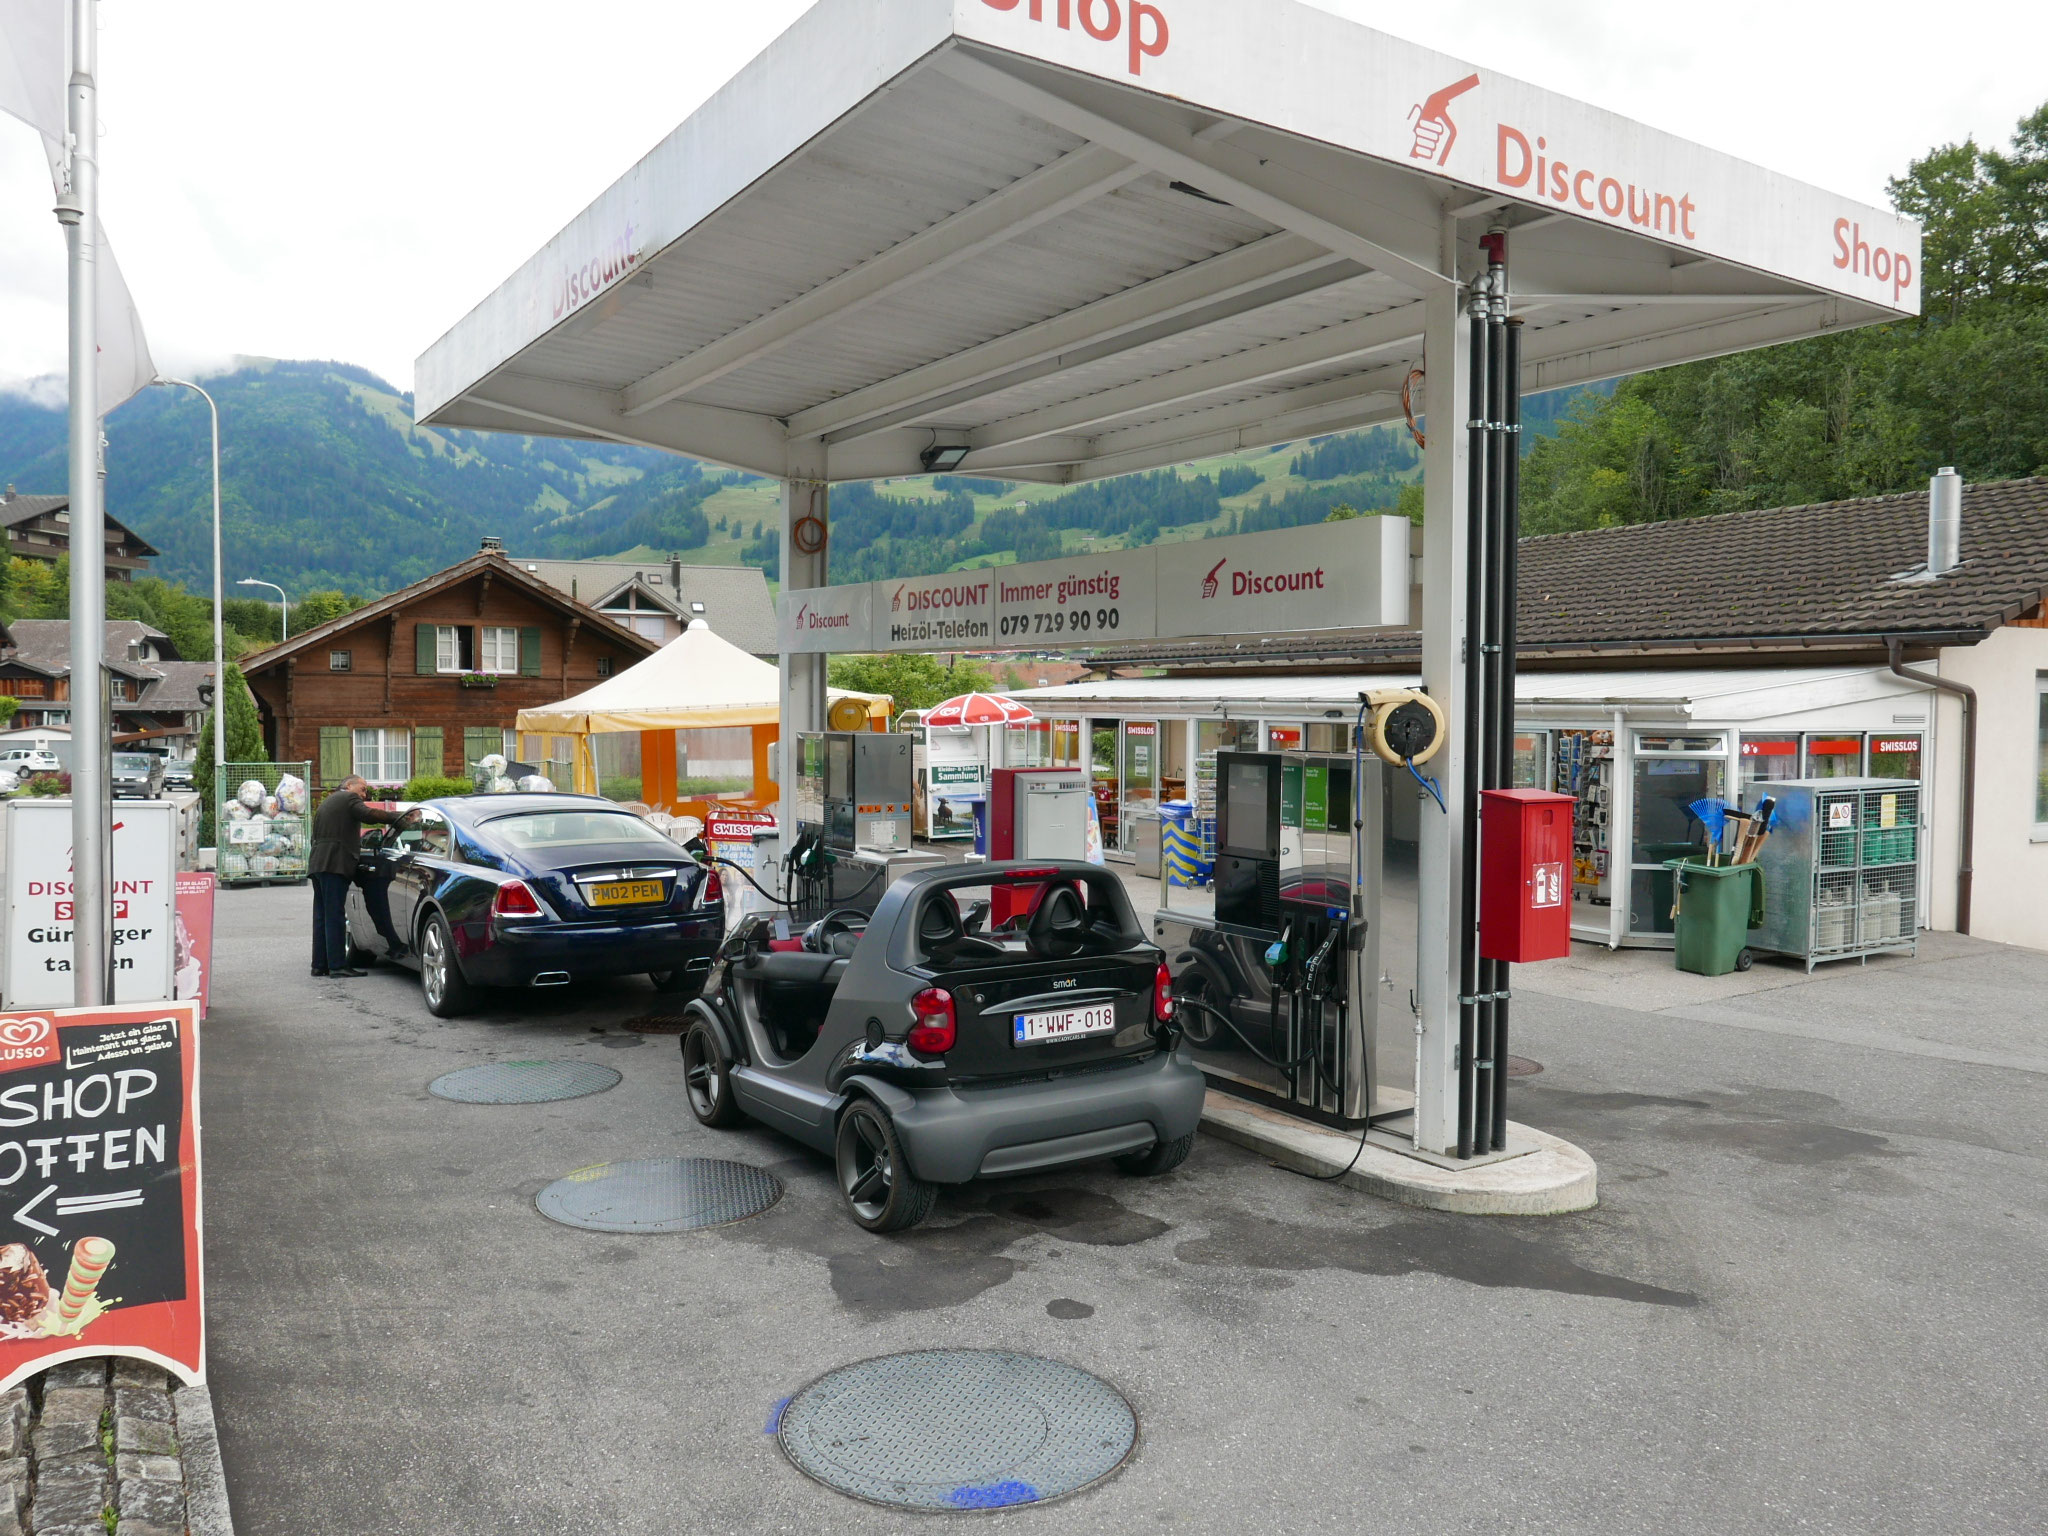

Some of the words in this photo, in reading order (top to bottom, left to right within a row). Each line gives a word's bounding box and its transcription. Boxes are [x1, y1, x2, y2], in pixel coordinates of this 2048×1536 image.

[981, 0, 1169, 76] op
[1497, 124, 1696, 240] Discount
[1833, 217, 1912, 302] Shop
[552, 219, 635, 320] Discount
[1232, 566, 1324, 596] Discount
[907, 584, 989, 611] DISCOUNT
[1000, 581, 1053, 604] Immer
[1057, 570, 1120, 604] günstig
[809, 613, 849, 629] Discount
[891, 619, 988, 642] Heizöl-Telefon
[1000, 614, 1029, 636] 079
[1034, 611, 1064, 633] 729
[1069, 609, 1091, 632] 90
[1096, 607, 1119, 630] 90
[1055, 724, 1078, 732] SWISSLOS
[1127, 726, 1155, 735] SWISSLOS
[861, 745, 867, 755] 1
[899, 745, 906, 755] 2
[1880, 741, 1918, 752] SWISSLOS
[938, 771, 978, 781] Sammlung
[714, 823, 760, 836] SWISS
[28, 880, 154, 896] DISCNT
[592, 886, 628, 900] PM02
[632, 884, 659, 898] PEM
[57, 902, 126, 919] SP
[27, 926, 153, 946] Günger
[44, 957, 134, 972] tan
[1306, 941, 1329, 990] DIESEL
[1053, 978, 1077, 989] smart
[99, 1031, 127, 1042] Jetzt
[128, 1027, 141, 1036] ein
[142, 1024, 168, 1034] Glace
[1017, 1030, 1024, 1039] B
[72, 1041, 120, 1056] Maintenant
[121, 1037, 139, 1047] une
[140, 1034, 162, 1046] glace
[97, 1048, 130, 1062] Adesso
[131, 1045, 143, 1054] un
[144, 1041, 173, 1054] gelato
[0, 1069, 158, 1127] SHOP
[0, 1124, 165, 1186] OFFEN
